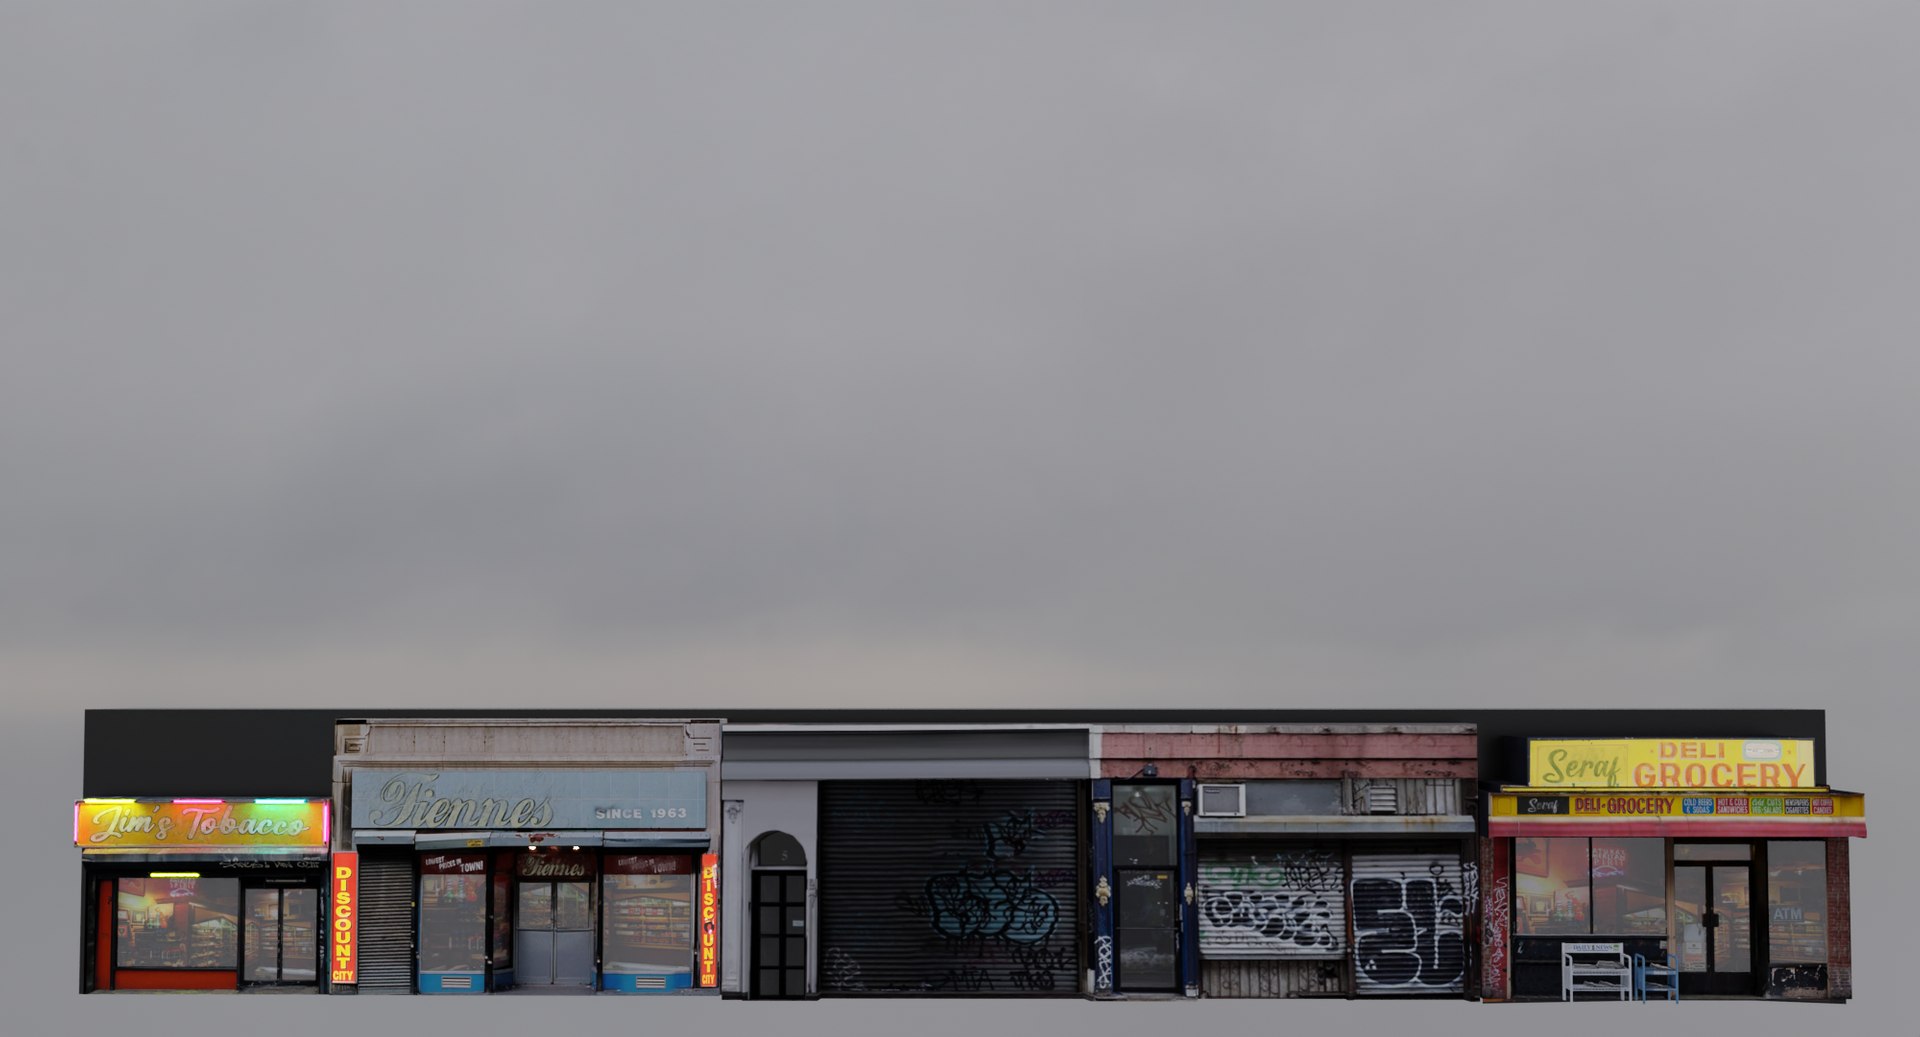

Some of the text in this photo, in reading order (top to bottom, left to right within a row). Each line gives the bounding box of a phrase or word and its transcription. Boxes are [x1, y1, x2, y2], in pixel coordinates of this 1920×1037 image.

[1658, 741, 1725, 759] DELI
[1542, 748, 1621, 787] Seraf
[1633, 762, 1806, 787] GROCERY
[368, 773, 554, 828] Fiennes
[1528, 797, 1560, 814] Seraf
[1575, 797, 1675, 814] DELI GROCERY
[595, 807, 687, 819] SINCE 1963
[90, 805, 309, 842] Jim's Tobacco
[460, 860, 484, 873] TOWN!
[522, 853, 585, 877] Fiennes
[335, 866, 352, 970] DISCOUNT
[1773, 907, 1801, 921] ATM
[332, 970, 353, 981] CITY
[701, 974, 715, 985] CITY
